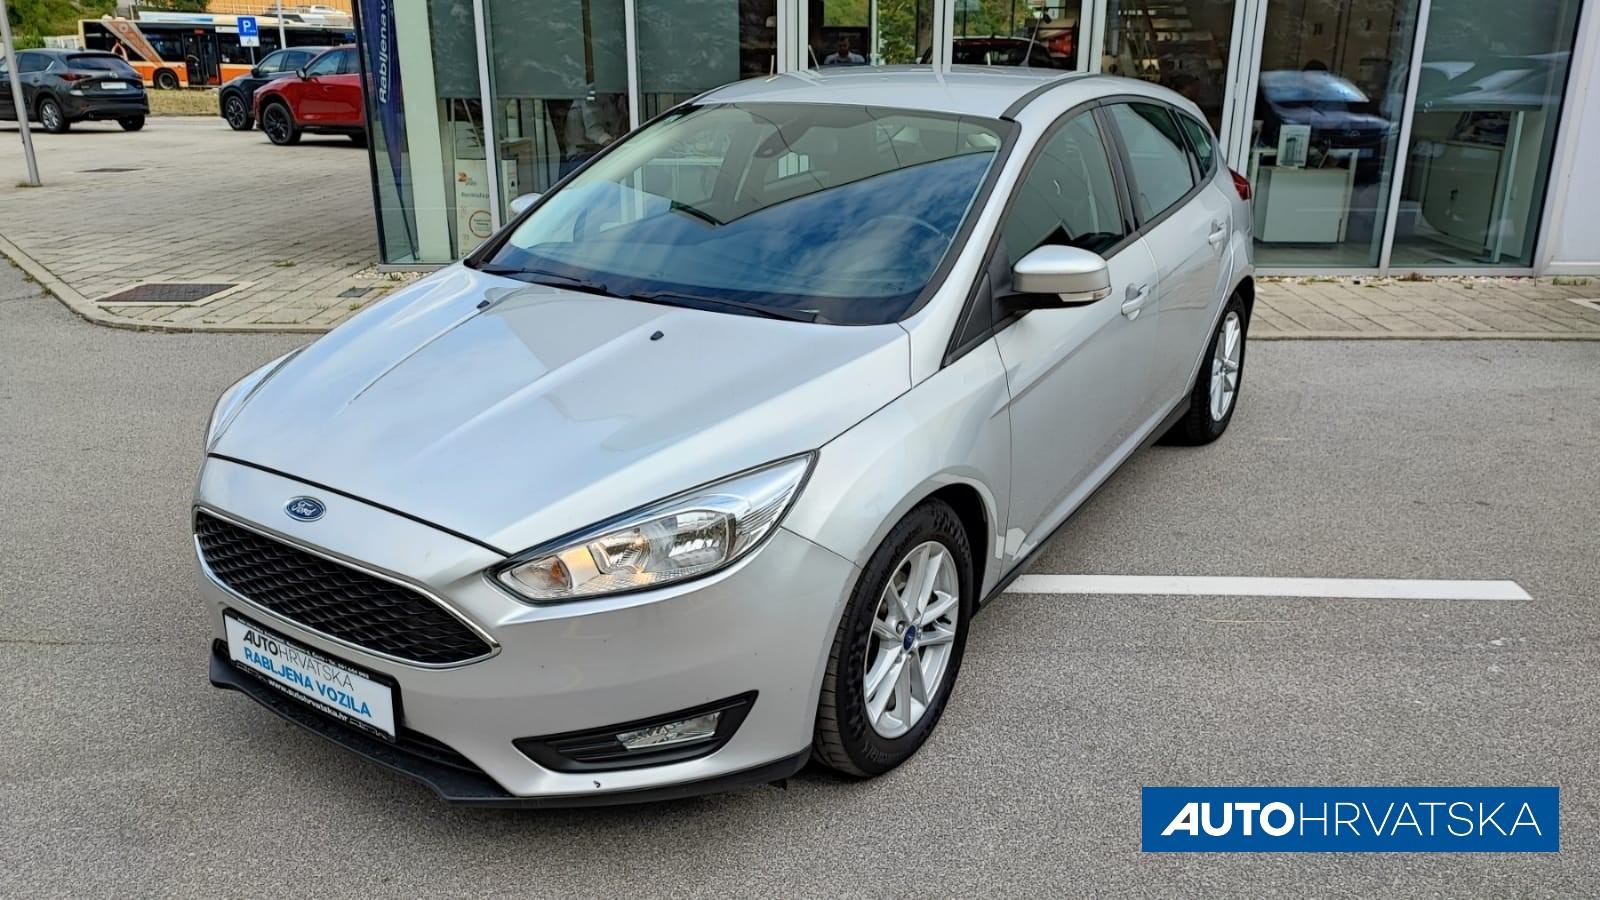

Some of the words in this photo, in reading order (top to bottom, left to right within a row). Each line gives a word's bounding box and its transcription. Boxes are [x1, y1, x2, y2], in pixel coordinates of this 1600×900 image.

[242, 20, 252, 33] P
[379, 14, 388, 104] Rabljena
[291, 500, 317, 516] Ford
[243, 630, 354, 691] AUTOHRVATSKA
[244, 647, 314, 691] RABLJENA
[315, 680, 372, 718] VOZILA
